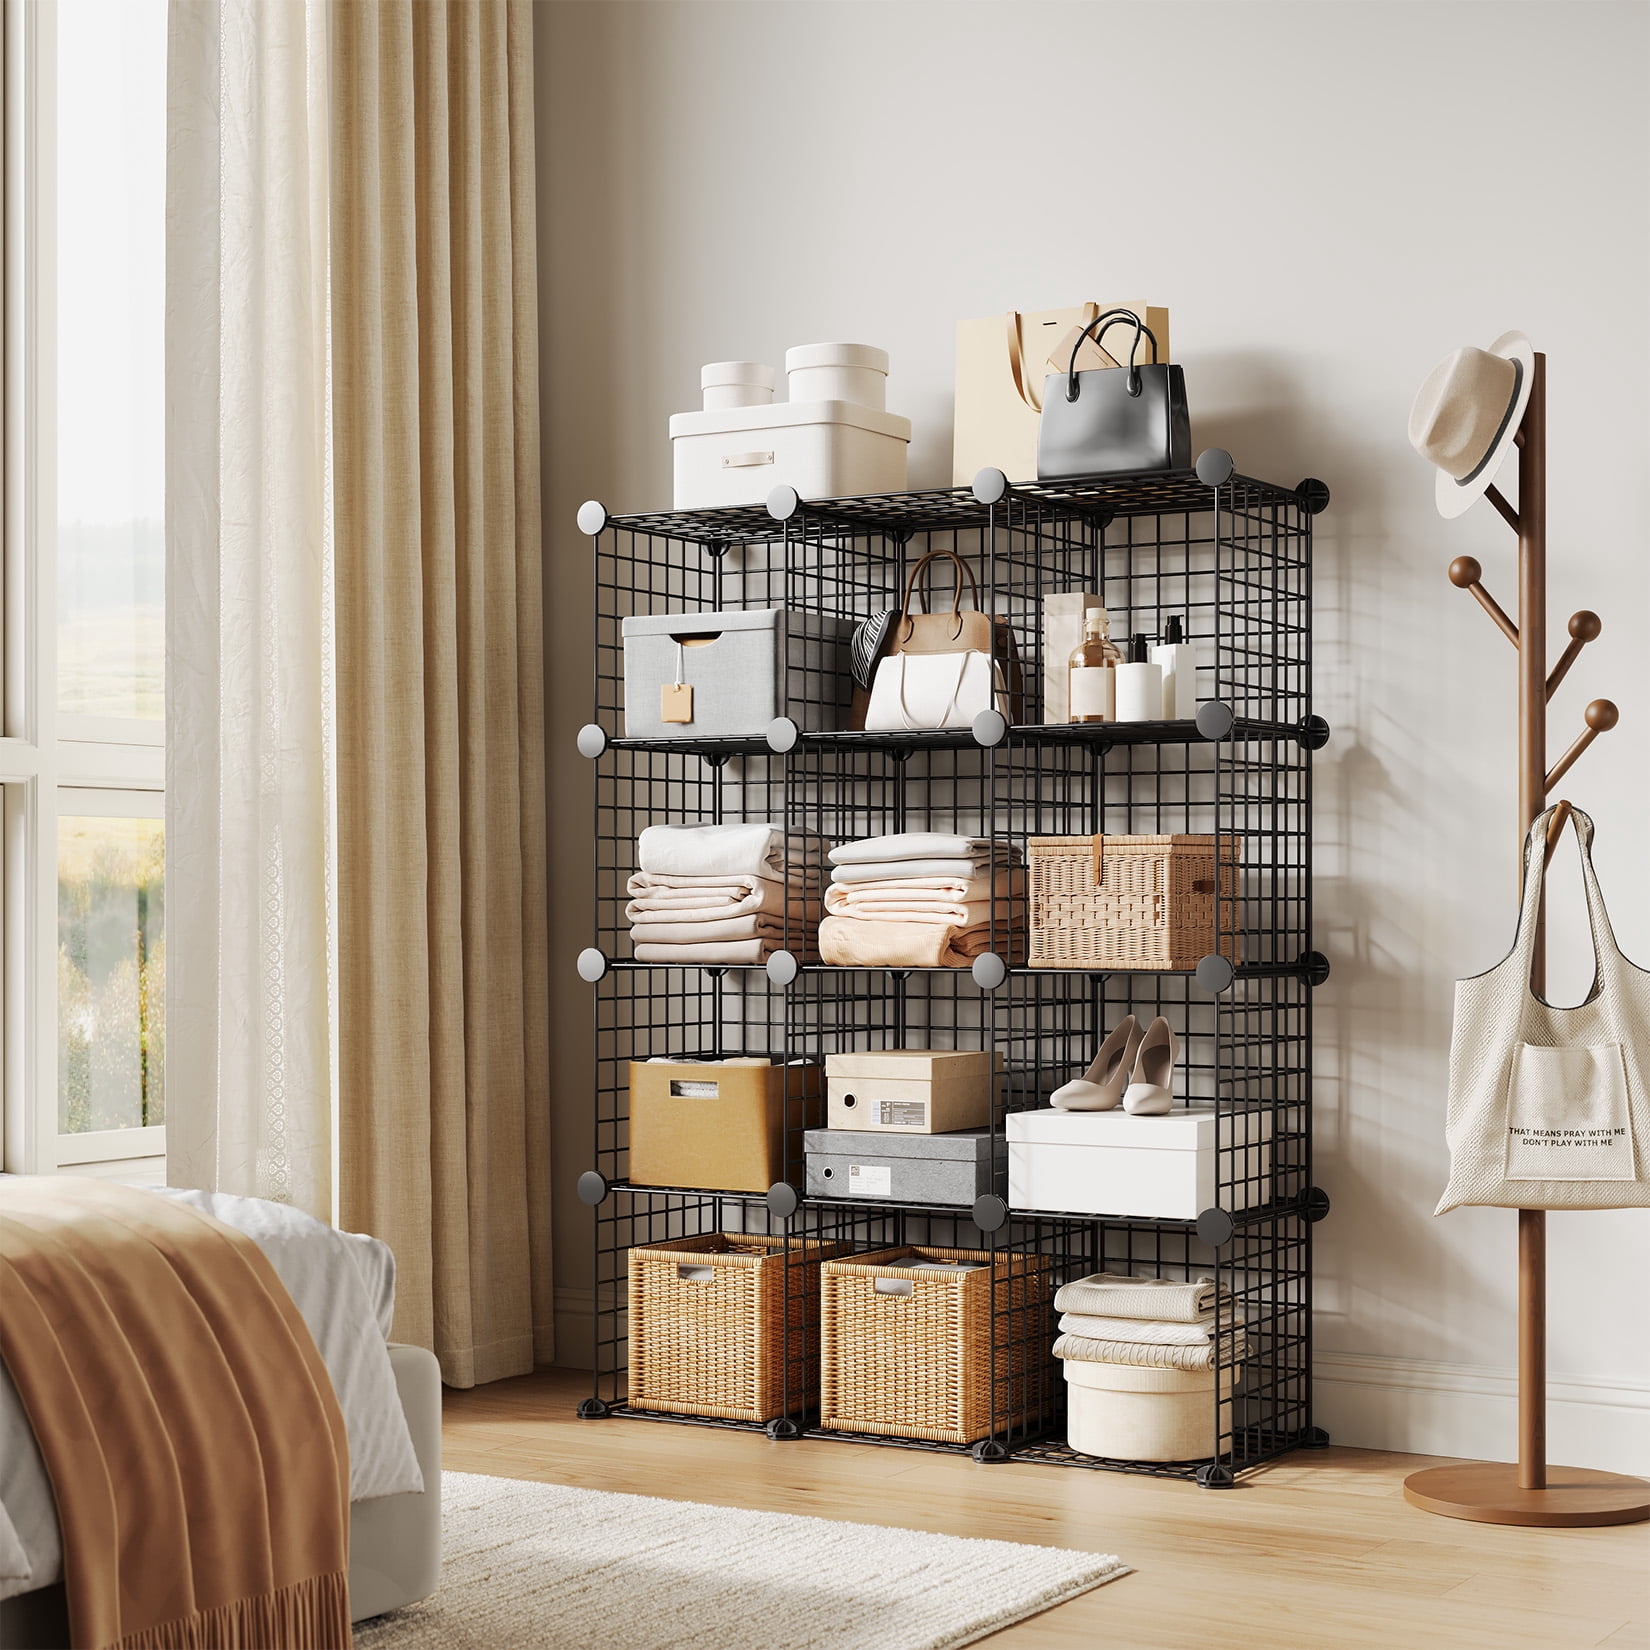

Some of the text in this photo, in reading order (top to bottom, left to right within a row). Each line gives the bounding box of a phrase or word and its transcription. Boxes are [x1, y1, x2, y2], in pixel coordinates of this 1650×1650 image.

[1509, 1127, 1626, 1138] THAT MEANS PRAY WITH ME
[1551, 1139, 1572, 1147] PLAY
[1574, 1139, 1598, 1147] WITH
[1600, 1138, 1613, 1146] ME
